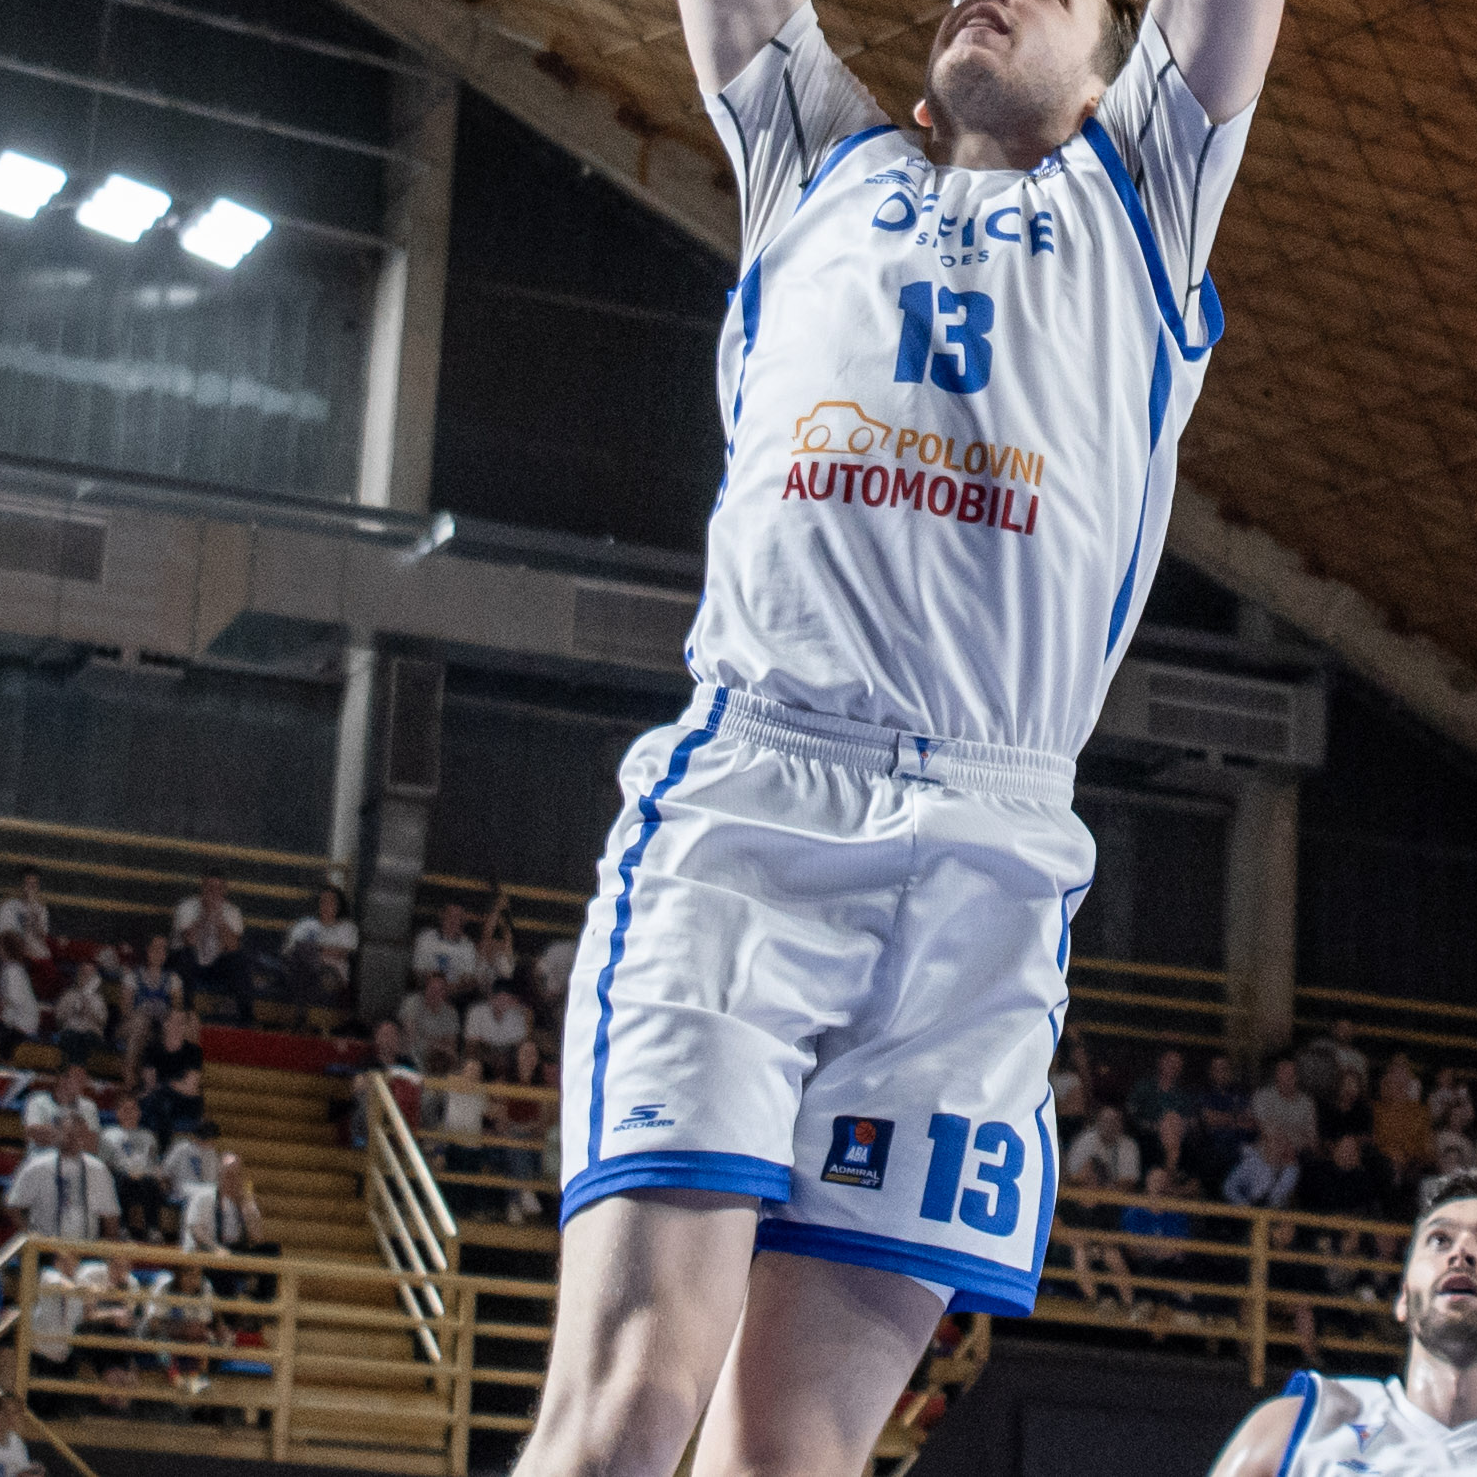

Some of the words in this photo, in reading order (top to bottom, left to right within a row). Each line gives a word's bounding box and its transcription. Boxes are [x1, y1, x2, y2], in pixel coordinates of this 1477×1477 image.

[915, 231, 990, 268] SOES
[894, 280, 996, 394] 13
[895, 428, 1045, 487] POLOVNI
[781, 461, 1040, 536] AUTOMOBILI
[829, 1163, 880, 1180] ADMIRAL
[919, 1113, 1025, 1237] 13
